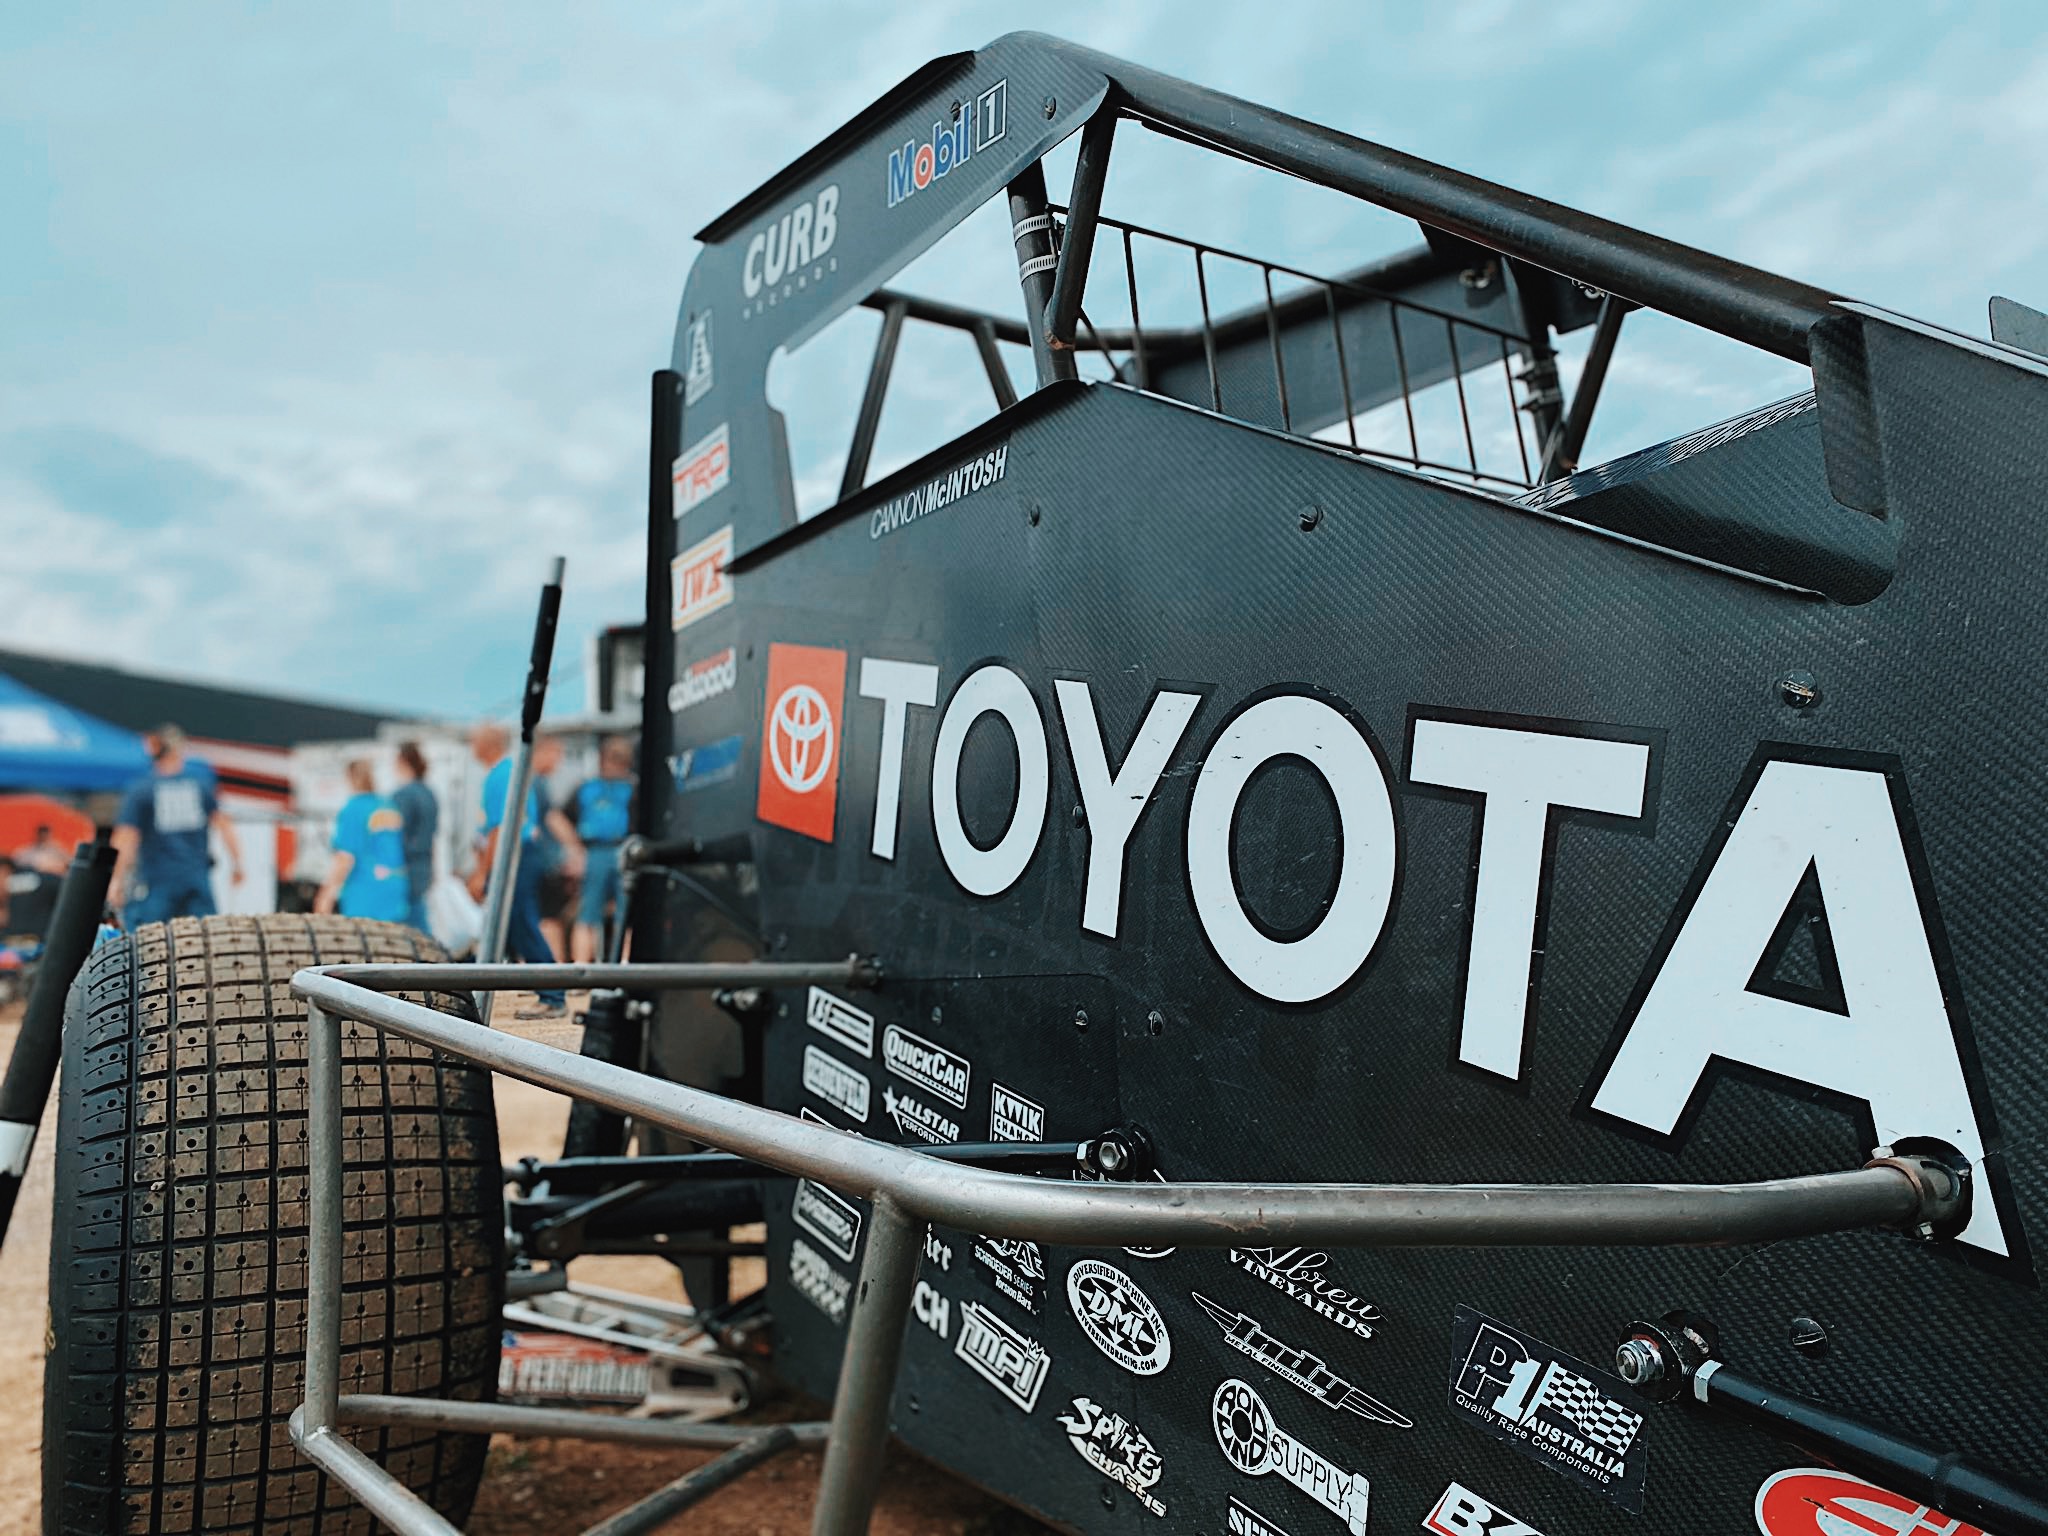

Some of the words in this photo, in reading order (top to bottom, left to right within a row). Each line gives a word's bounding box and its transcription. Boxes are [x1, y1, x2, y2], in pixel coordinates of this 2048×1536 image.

[888, 100, 972, 209] Mobil
[743, 184, 840, 299] CURB
[858, 655, 2010, 1258] TOYOTA
[898, 1095, 960, 1142] ALLSTAR
[901, 1117, 949, 1144] PERFORMA
[994, 1090, 1041, 1137] KWIK
[1087, 1288, 1145, 1343] DMI
[1230, 1248, 1373, 1339] VINEYARDS
[1261, 1357, 1317, 1394] FINISHING
[1270, 1433, 1350, 1510] SUPPLY
[1455, 1394, 1496, 1423] Quality
[1499, 1416, 1528, 1440] Race
[1531, 1436, 1610, 1485] Components
[1525, 1416, 1626, 1478] AUSTRALIA
[1087, 1441, 1167, 1518] CHASSIS
